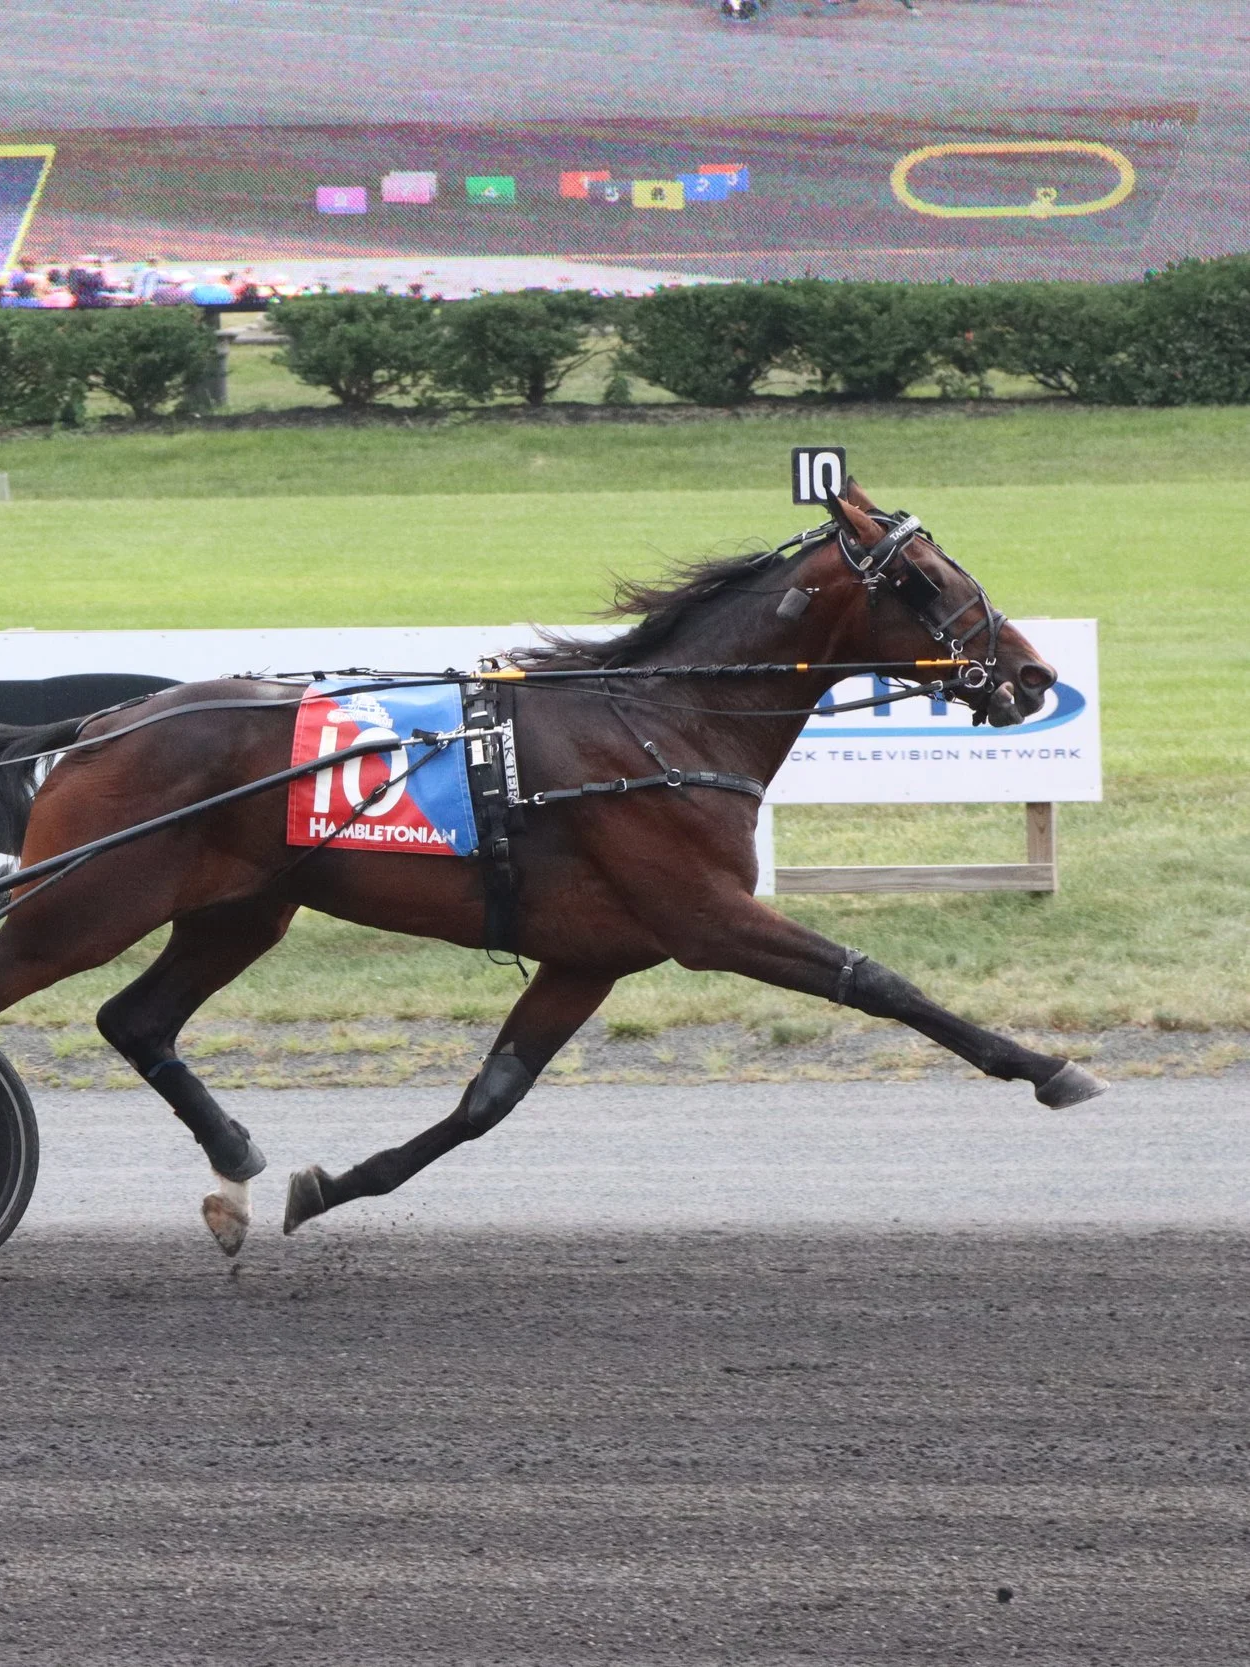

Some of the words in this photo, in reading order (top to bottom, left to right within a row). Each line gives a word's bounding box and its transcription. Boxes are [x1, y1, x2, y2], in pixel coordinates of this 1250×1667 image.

[799, 451, 842, 500] 10
[313, 726, 409, 817] 10
[828, 750, 960, 761] TELEVISION
[969, 748, 1082, 760] NETWORK
[309, 817, 456, 844] HAMBLETONIAN
